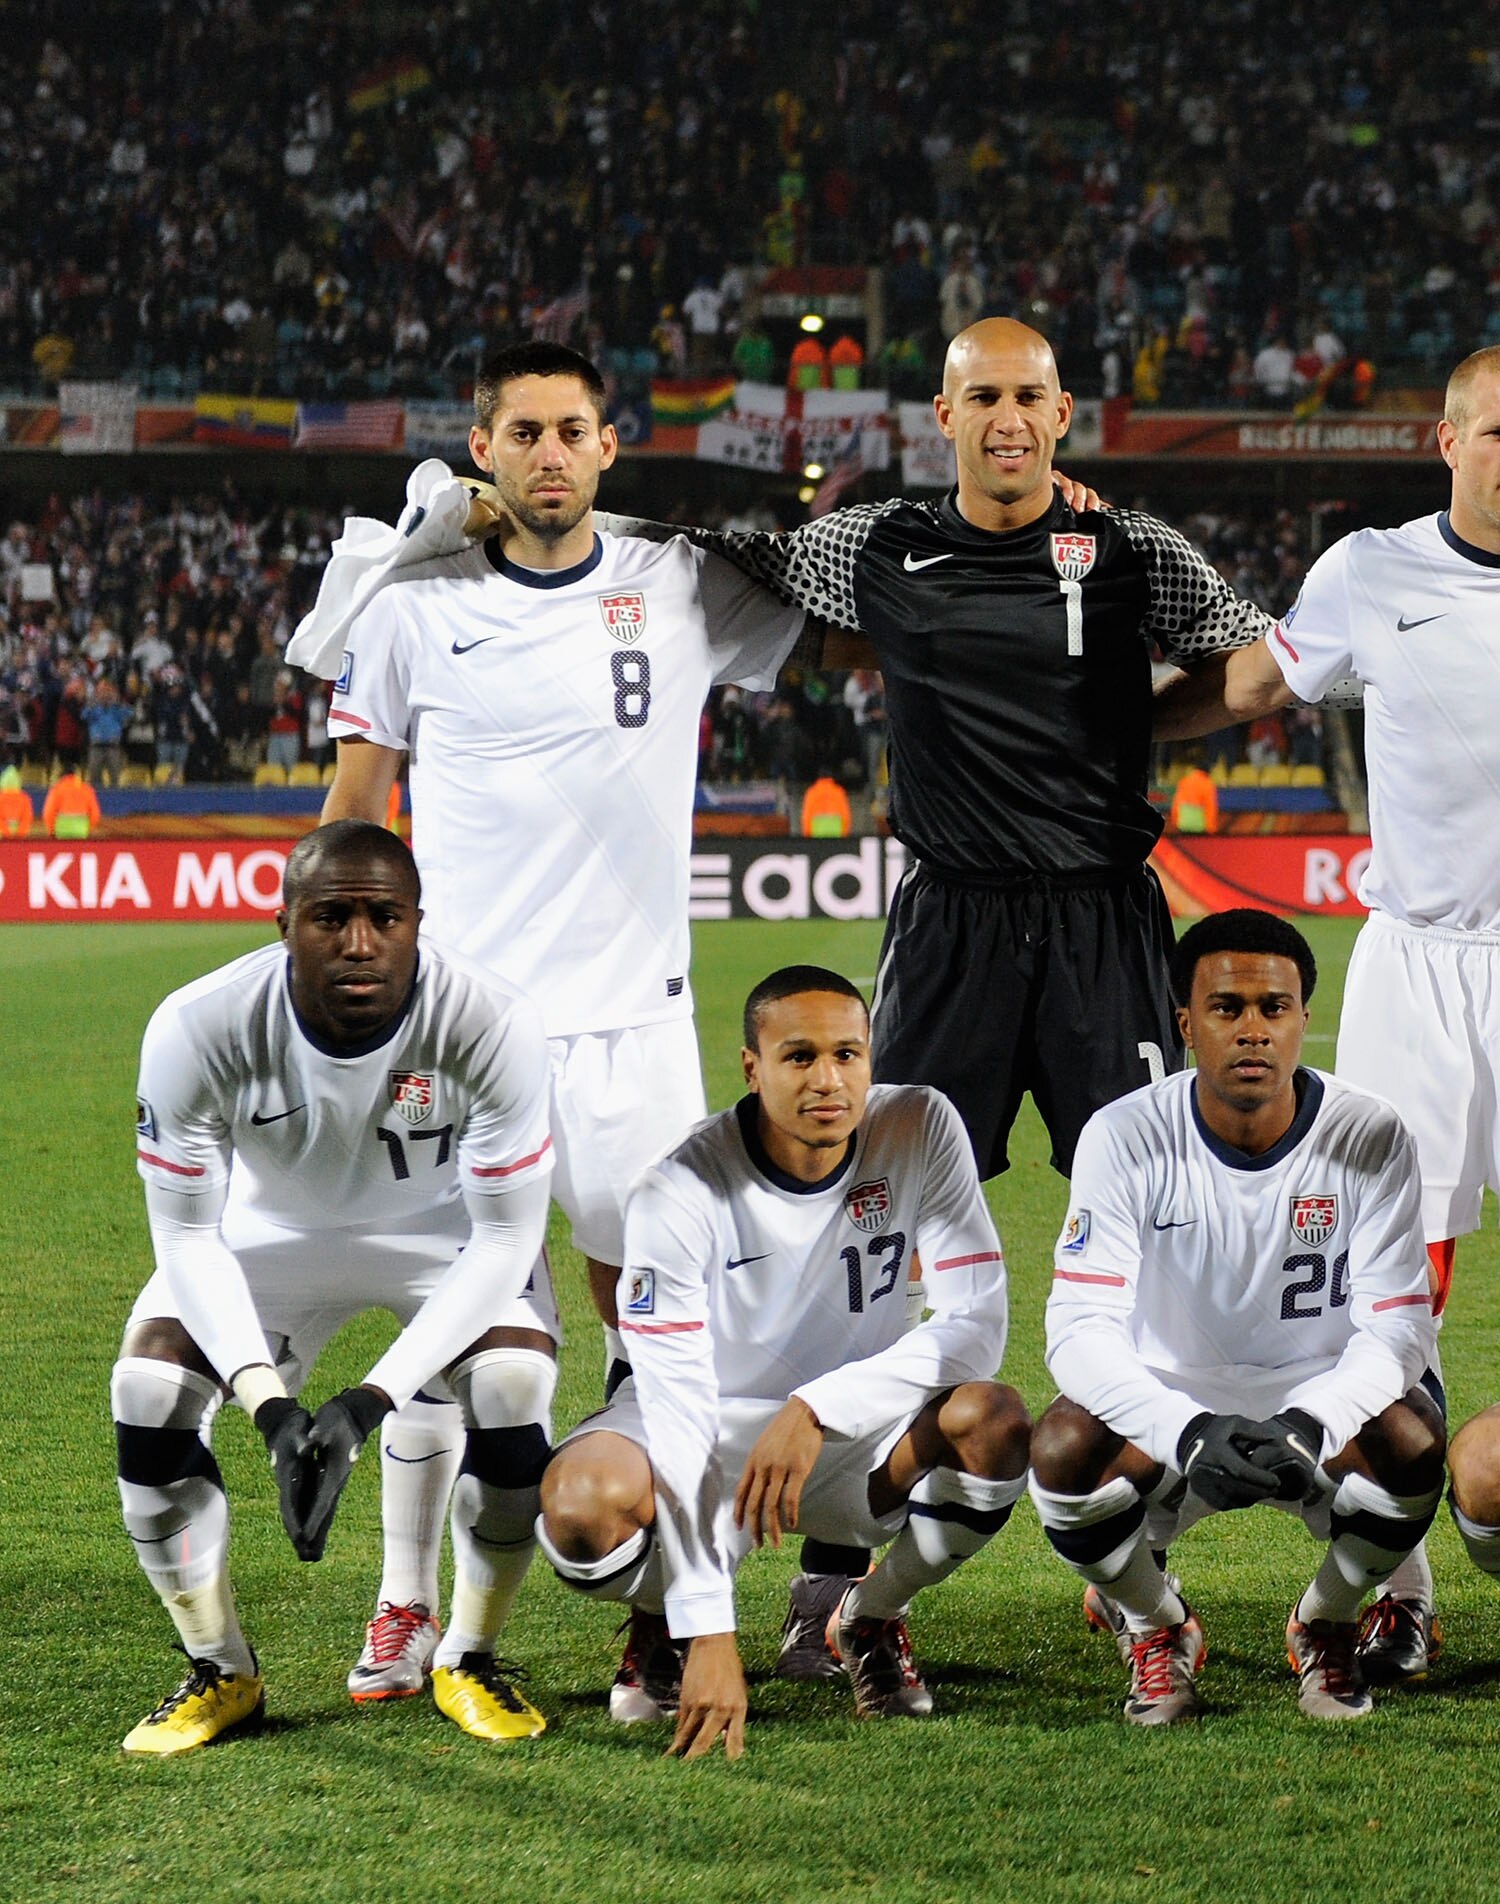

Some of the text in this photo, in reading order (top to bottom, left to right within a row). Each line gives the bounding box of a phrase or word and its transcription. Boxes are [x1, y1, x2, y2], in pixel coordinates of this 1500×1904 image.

[1059, 580, 1083, 656] 1
[611, 650, 651, 728] 8
[28, 849, 287, 910] KIA MO
[743, 836, 905, 920] adi
[1303, 848, 1372, 905] RO
[377, 1123, 453, 1180] 17
[840, 1231, 906, 1313] 13
